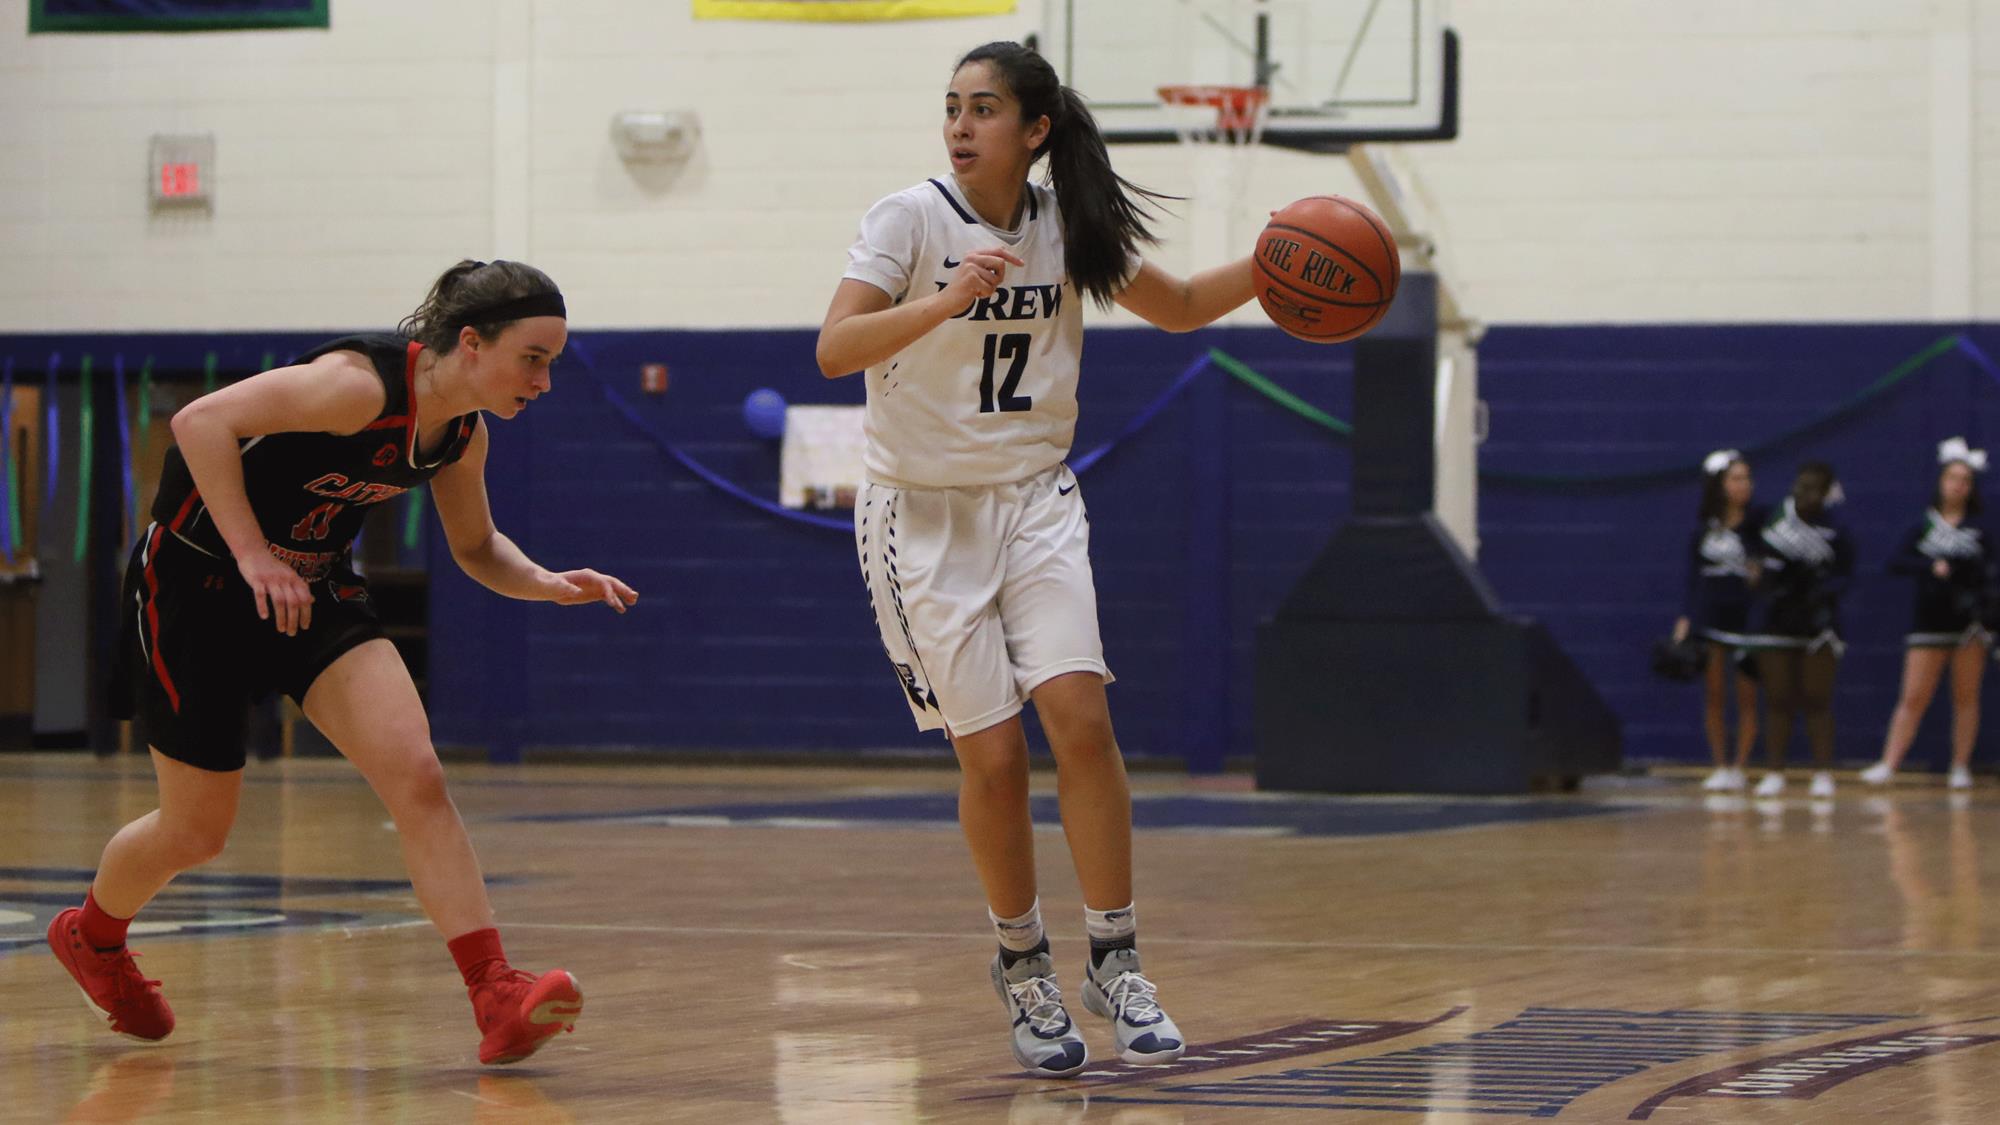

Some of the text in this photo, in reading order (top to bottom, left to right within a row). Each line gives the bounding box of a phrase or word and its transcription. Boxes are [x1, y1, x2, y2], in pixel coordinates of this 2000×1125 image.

[1263, 238, 1358, 295] THE ROCK
[979, 333, 1032, 413] 12
